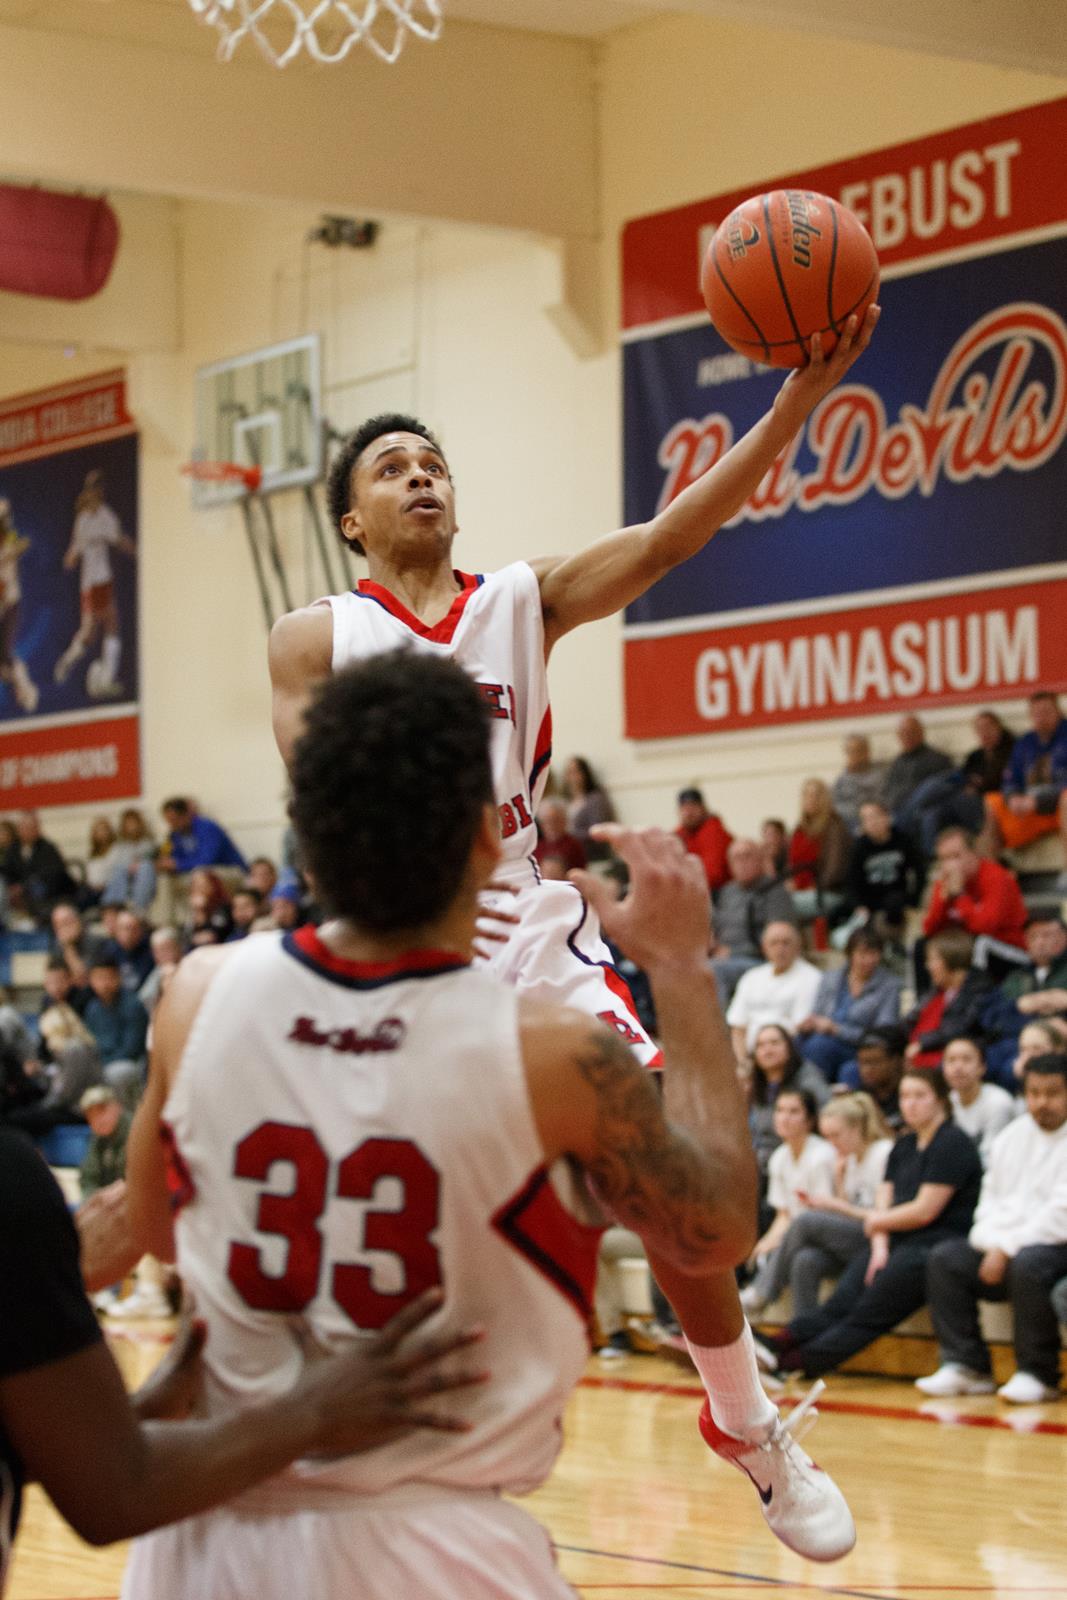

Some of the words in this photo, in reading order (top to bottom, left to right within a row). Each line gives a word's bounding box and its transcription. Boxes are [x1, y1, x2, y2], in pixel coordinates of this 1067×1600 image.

[796, 301, 1067, 509] Devils
[694, 605, 1039, 721] GYMNASIUM
[227, 1119, 447, 1331] 33
